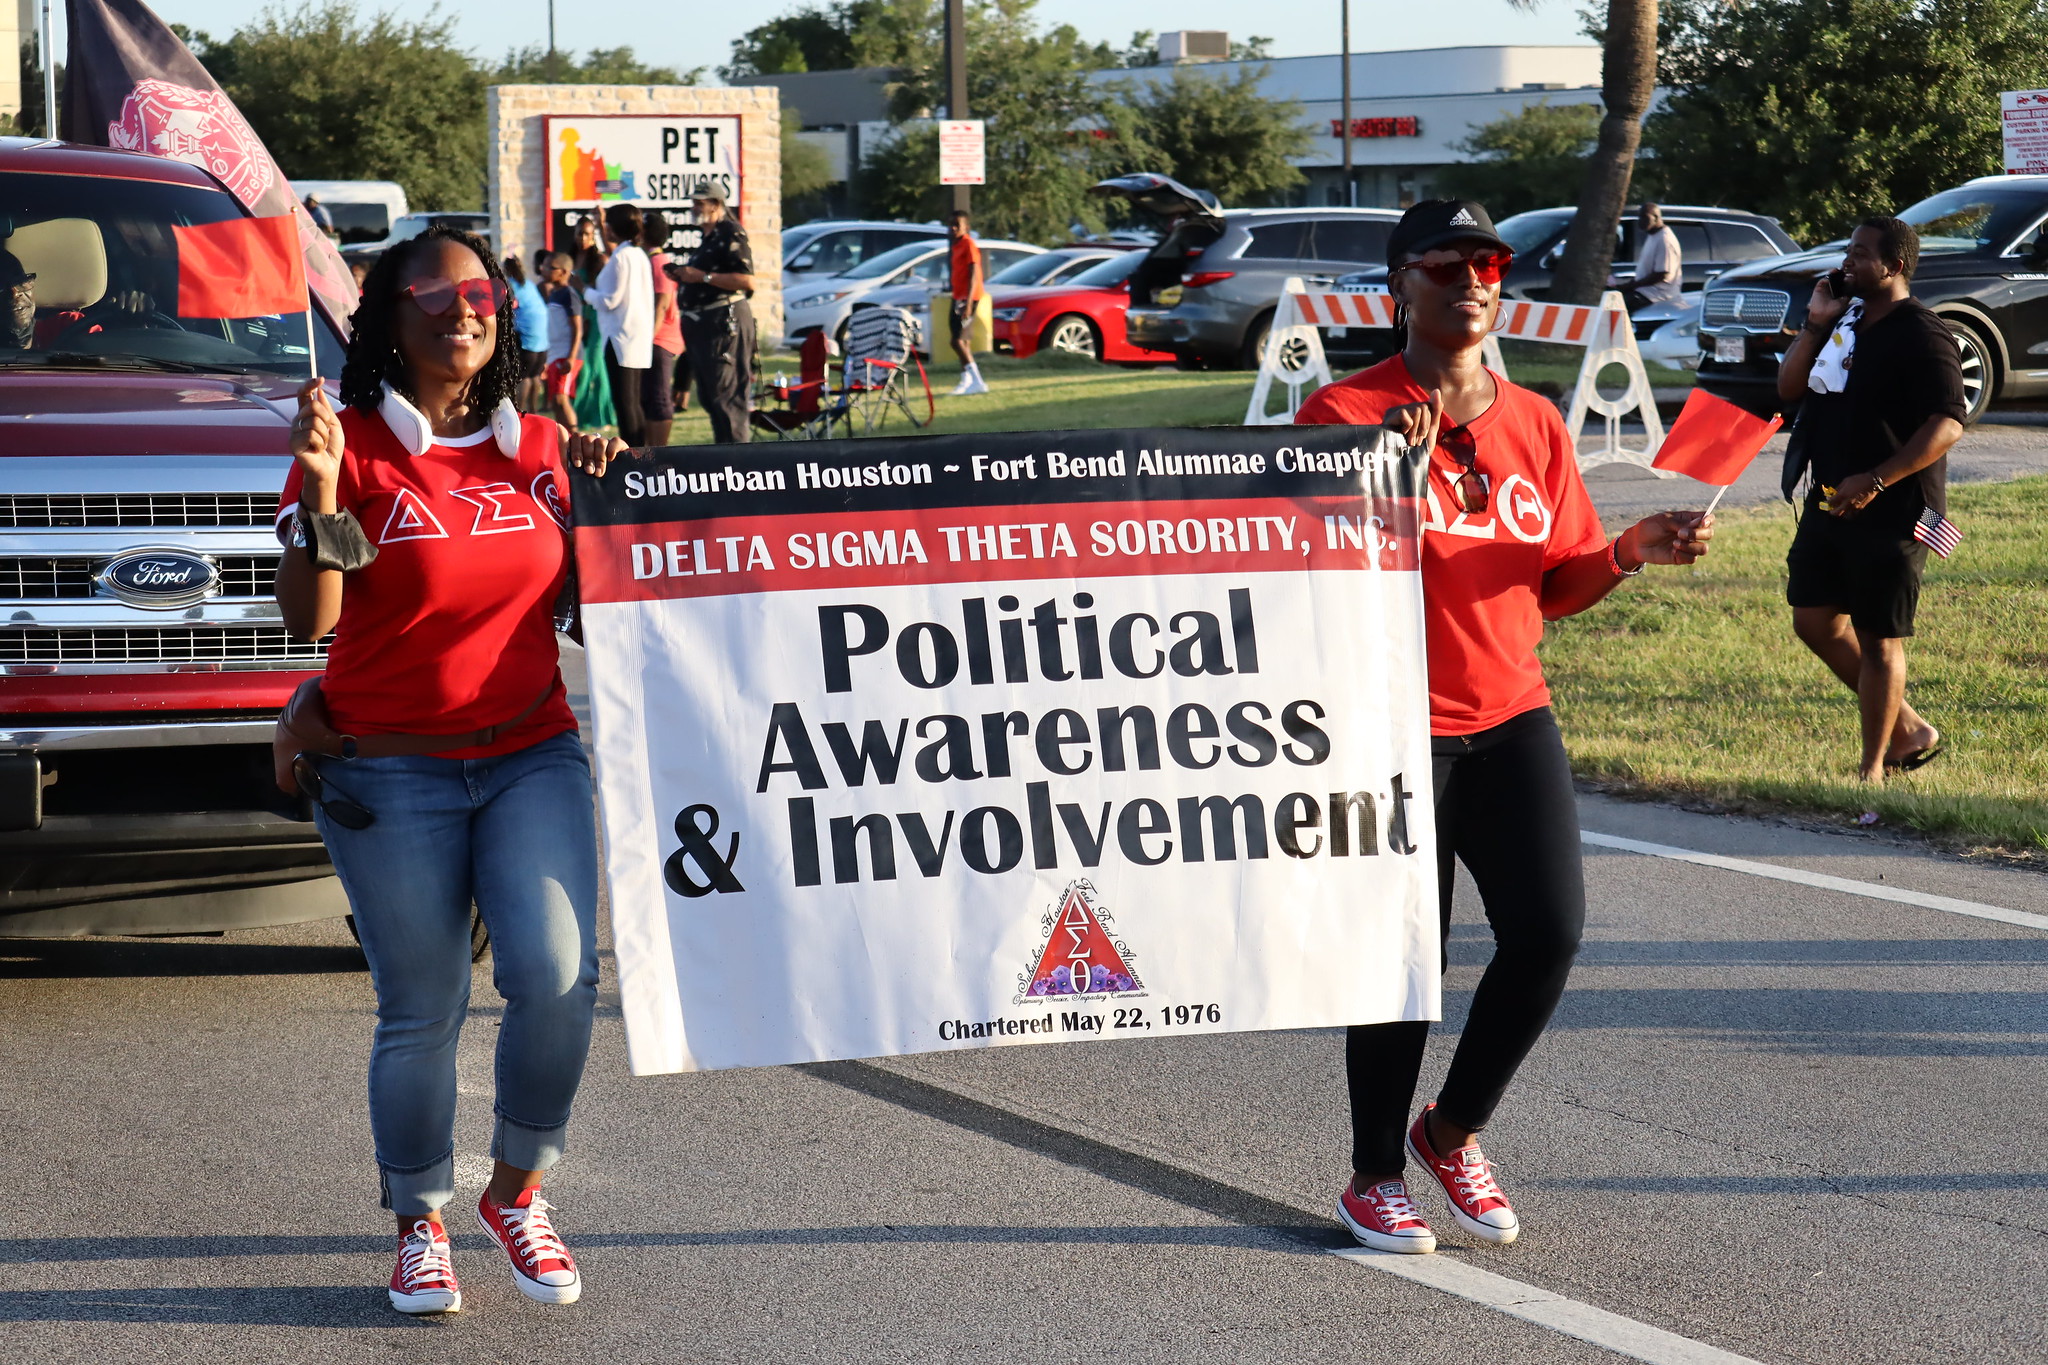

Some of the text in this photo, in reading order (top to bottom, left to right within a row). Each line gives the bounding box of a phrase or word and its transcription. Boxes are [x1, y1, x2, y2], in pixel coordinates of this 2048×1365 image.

[662, 127, 719, 163] PET
[1449, 218, 1478, 226] adidas
[624, 465, 786, 499] Suburban
[796, 460, 933, 490] Houston
[971, 454, 1038, 482] Fort
[1047, 449, 1126, 479] Bend
[1136, 447, 1266, 477] Alumnae
[132, 560, 193, 585] Ford
[631, 515, 1398, 580] DELTA SIGMA THETA SORORITY, INC.
[818, 587, 1259, 693] Political
[756, 699, 1331, 793] Awareness
[662, 772, 1417, 898] & Involvement
[1041, 887, 1070, 938] Houston
[1091, 906, 1118, 937] Bend
[938, 1003, 1221, 1041] Chartered May 22, 1976
